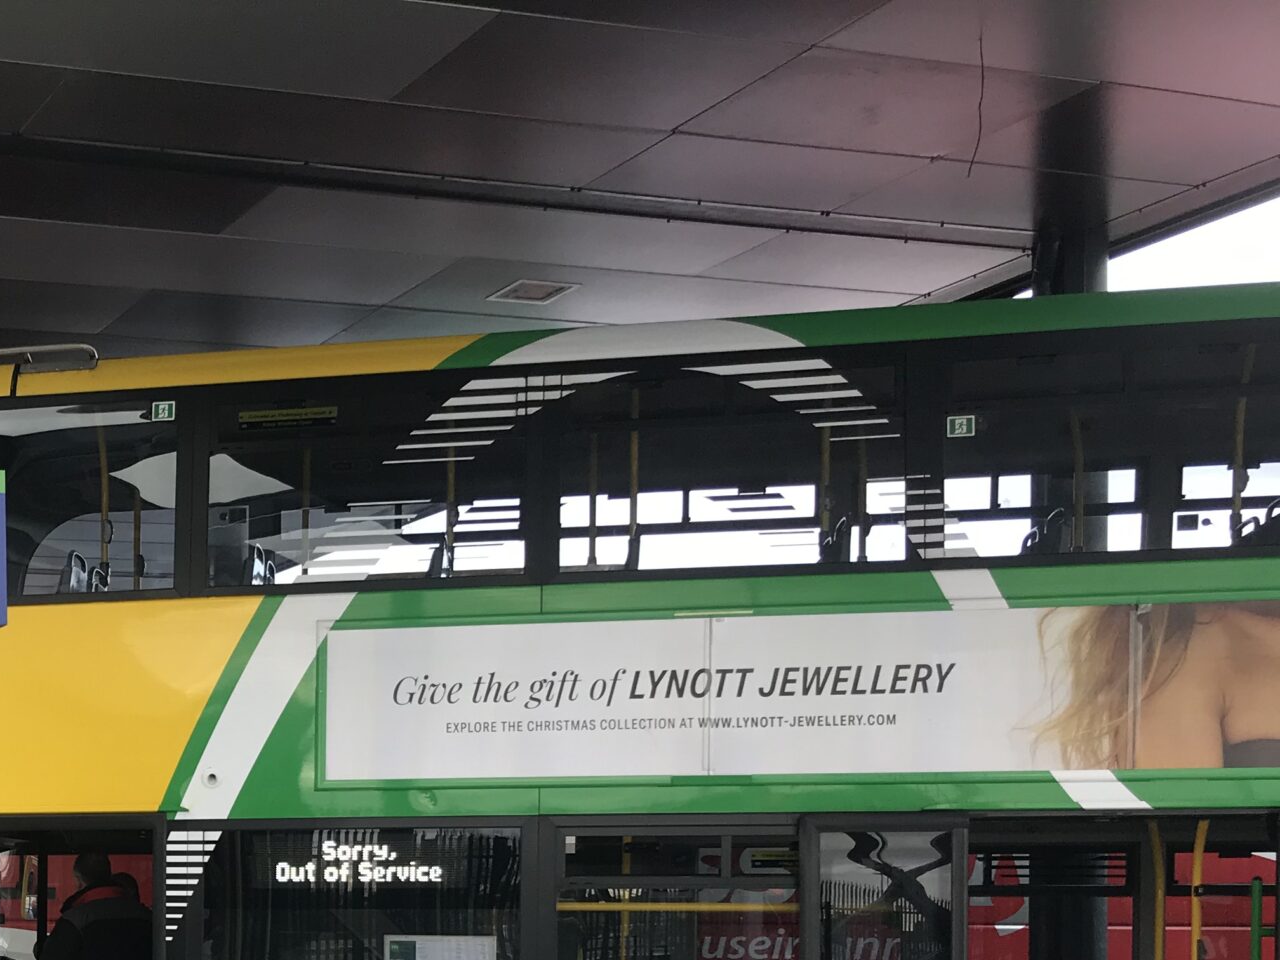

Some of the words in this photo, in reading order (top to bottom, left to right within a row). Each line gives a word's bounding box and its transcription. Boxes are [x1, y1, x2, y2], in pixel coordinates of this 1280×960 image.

[392, 675, 463, 706] Give
[470, 672, 519, 703] the
[524, 669, 582, 709] gift
[589, 668, 627, 707] of
[628, 668, 755, 699] LYNOTT
[758, 663, 957, 698] JEWELLERY
[445, 721, 498, 734] EXPLORE
[501, 721, 524, 732] THE
[526, 719, 597, 732] CHRISTMAS
[599, 718, 676, 731] COLLECTION
[679, 717, 695, 729] AT
[697, 714, 897, 729] WWW.LYNOTT-JEWELLERY.COM
[321, 840, 397, 861] Sorry,
[275, 861, 317, 883] Out
[323, 861, 350, 883] of
[357, 861, 443, 883] Service
